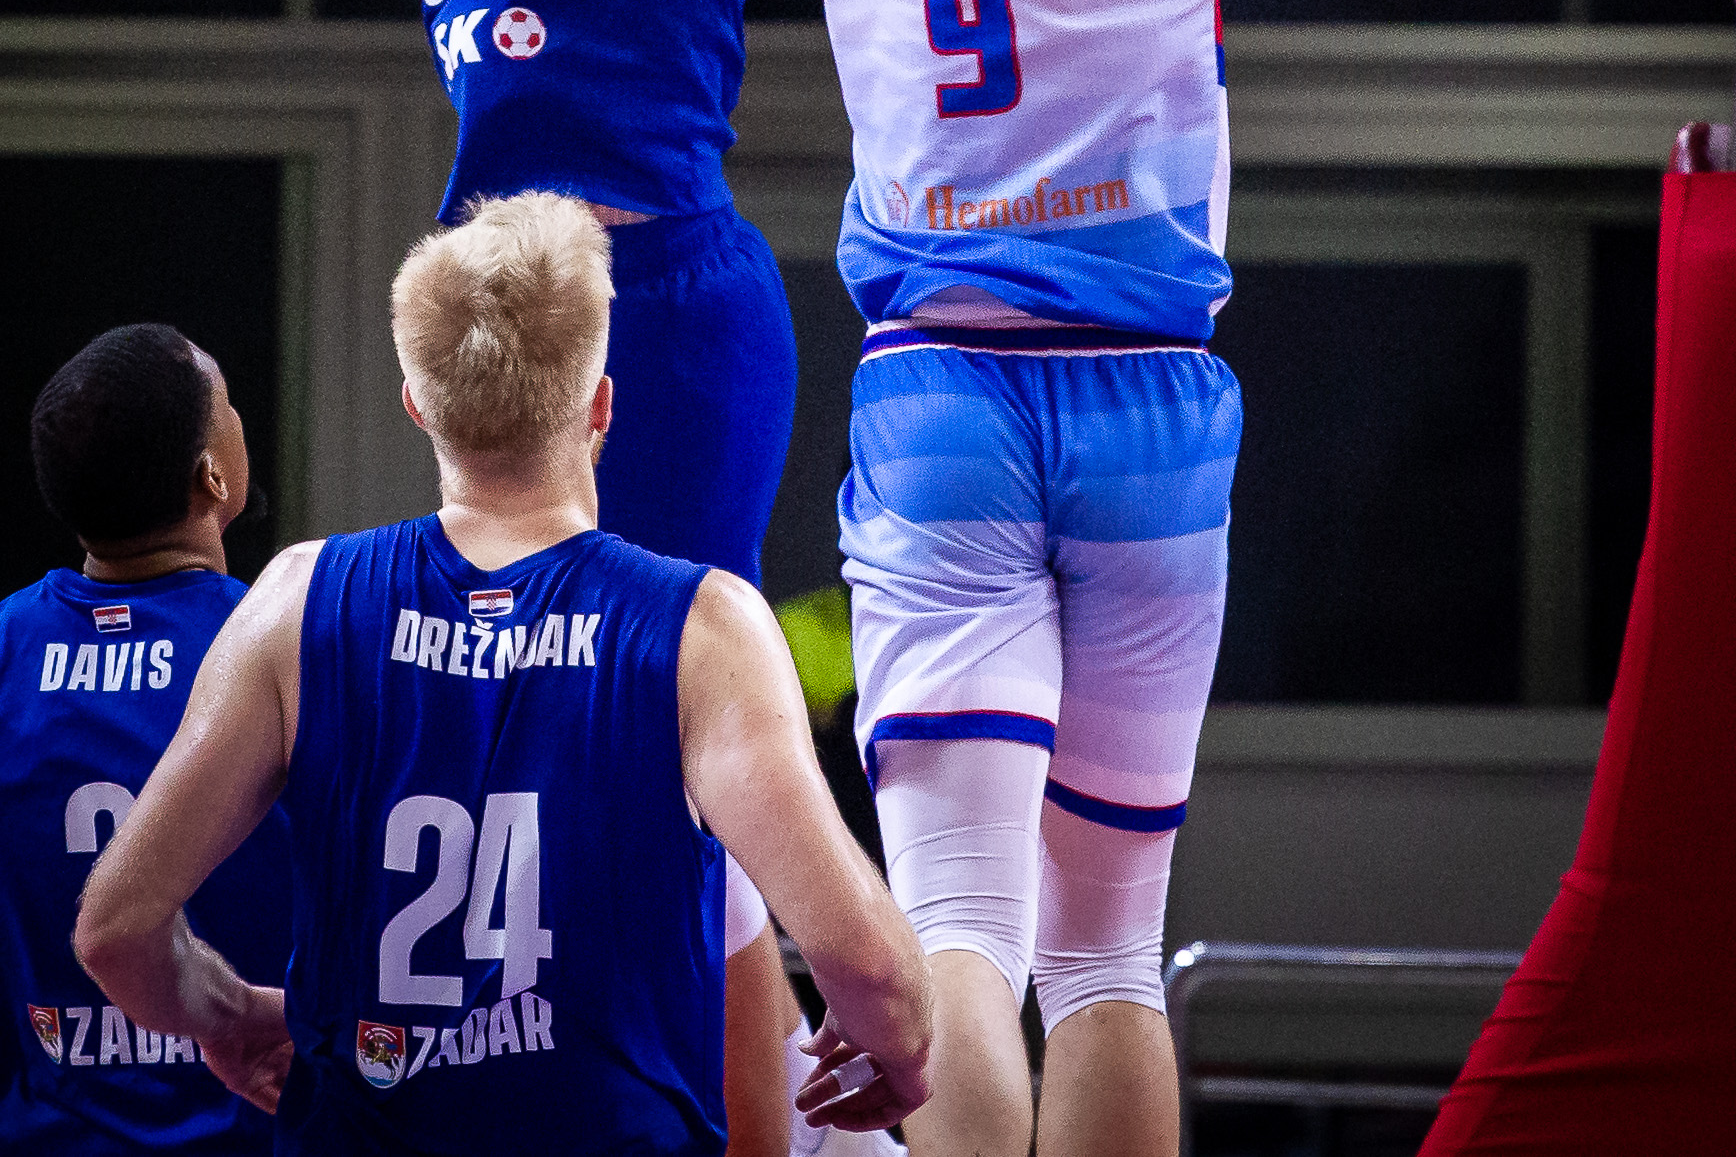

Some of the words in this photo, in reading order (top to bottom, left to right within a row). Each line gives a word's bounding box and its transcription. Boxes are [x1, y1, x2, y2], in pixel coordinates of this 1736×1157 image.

[925, 176, 1131, 230] Hemofarm
[39, 639, 173, 692] DAVIS
[391, 607, 601, 679] DREŽNJAK
[379, 792, 552, 1006] 24
[65, 1005, 208, 1066] ZADA
[407, 991, 555, 1079] ZADAR
